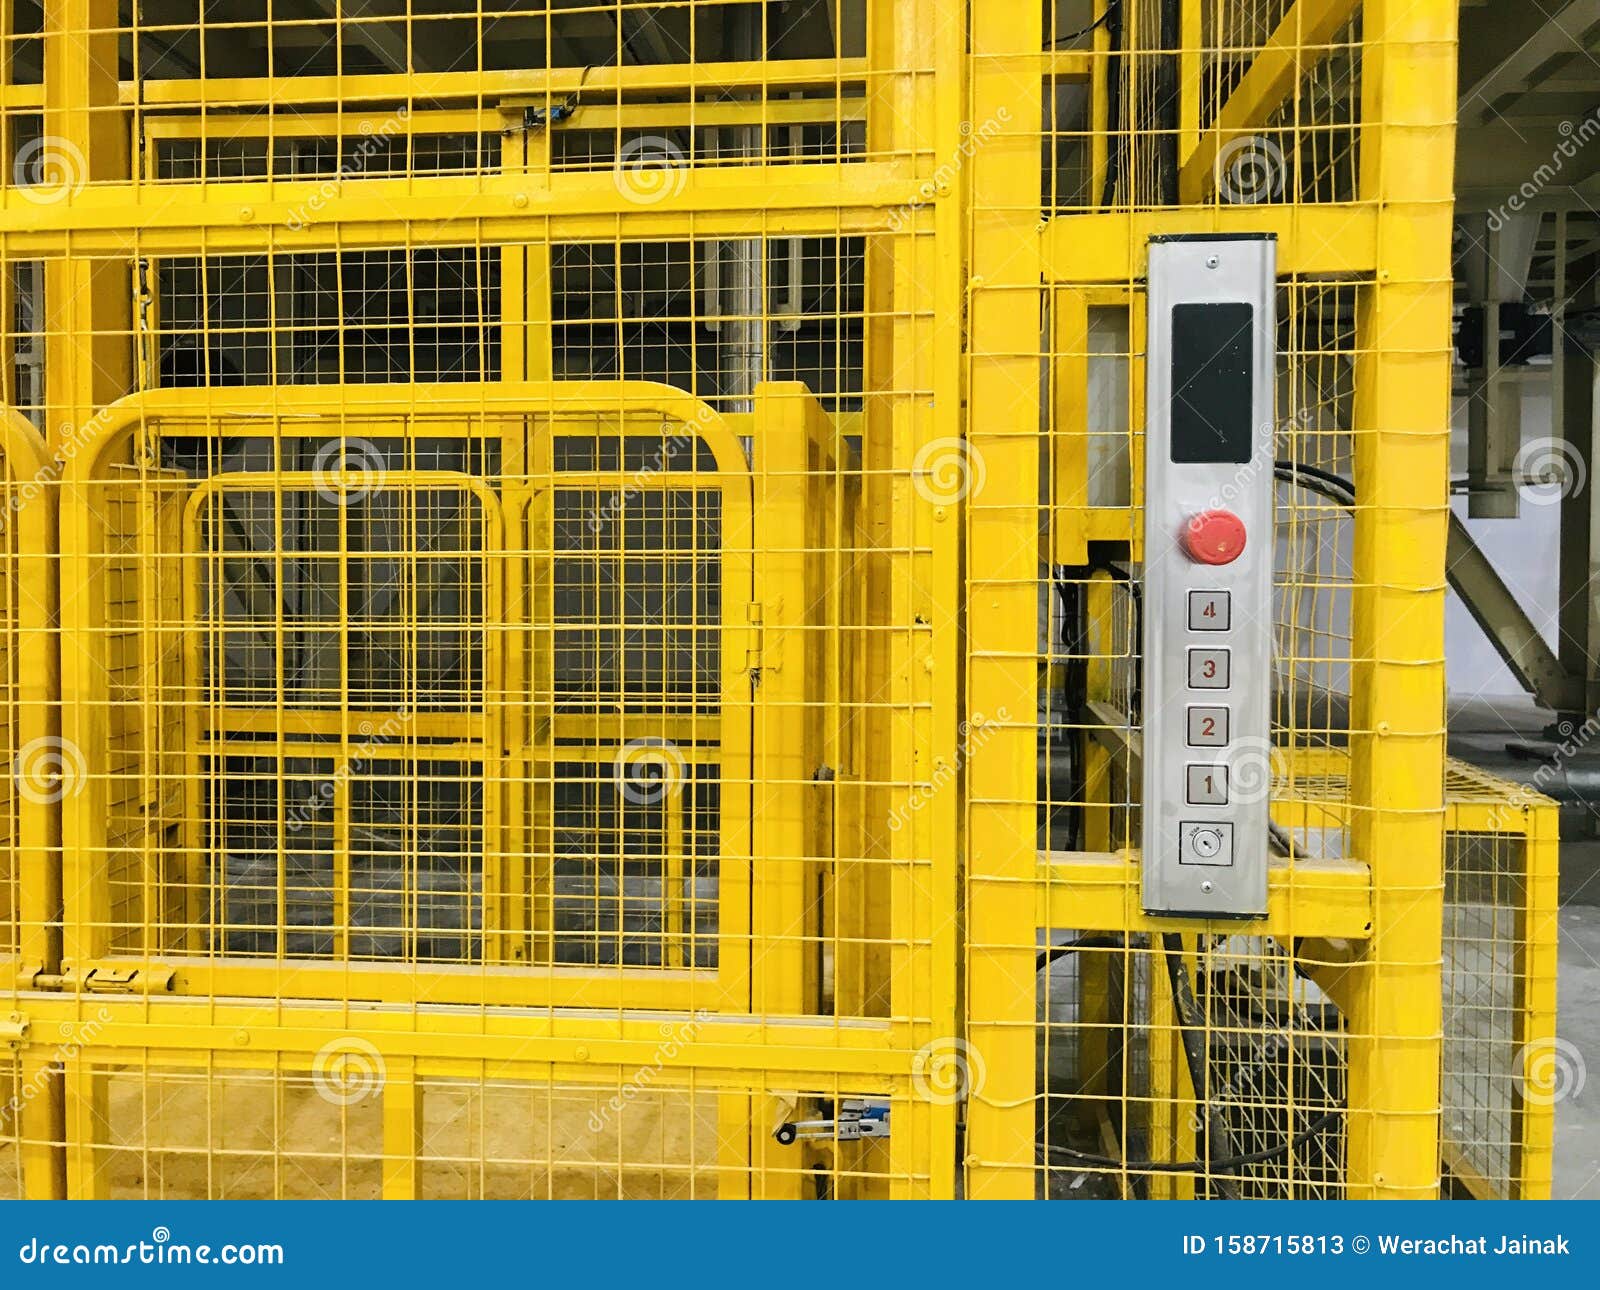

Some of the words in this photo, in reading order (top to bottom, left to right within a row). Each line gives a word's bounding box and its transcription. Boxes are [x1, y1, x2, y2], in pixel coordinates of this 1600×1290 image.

[1203, 601, 1216, 618] 4
[1203, 660, 1216, 679] 3
[1202, 717, 1216, 736] 2
[1204, 775, 1213, 794] 1
